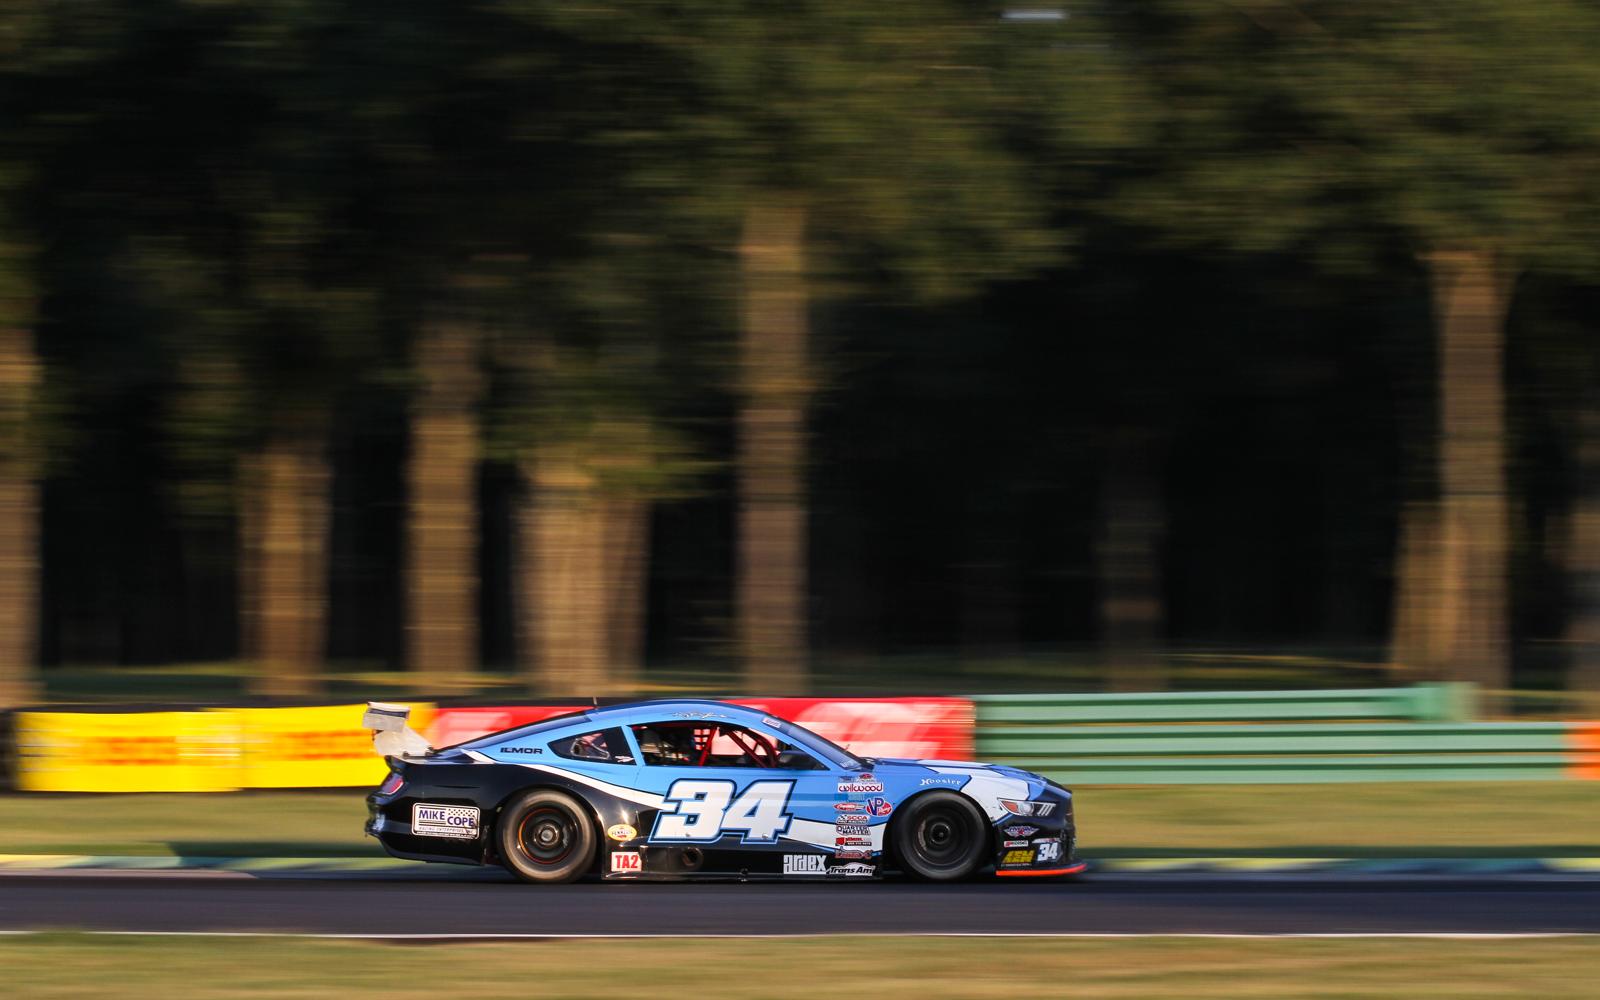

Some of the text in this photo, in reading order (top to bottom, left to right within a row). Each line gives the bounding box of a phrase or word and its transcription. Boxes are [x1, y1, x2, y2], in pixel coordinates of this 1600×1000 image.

[838, 783, 883, 792] wilwood
[920, 778, 961, 786] Hoosier
[648, 778, 797, 843] 34
[867, 797, 885, 816] VP
[418, 810, 445, 820] MIKE
[447, 816, 475, 826] COPE
[1037, 842, 1058, 862] 34
[615, 854, 639, 869] TA2
[783, 854, 827, 875] ardex
[827, 866, 873, 875] Trans Am
